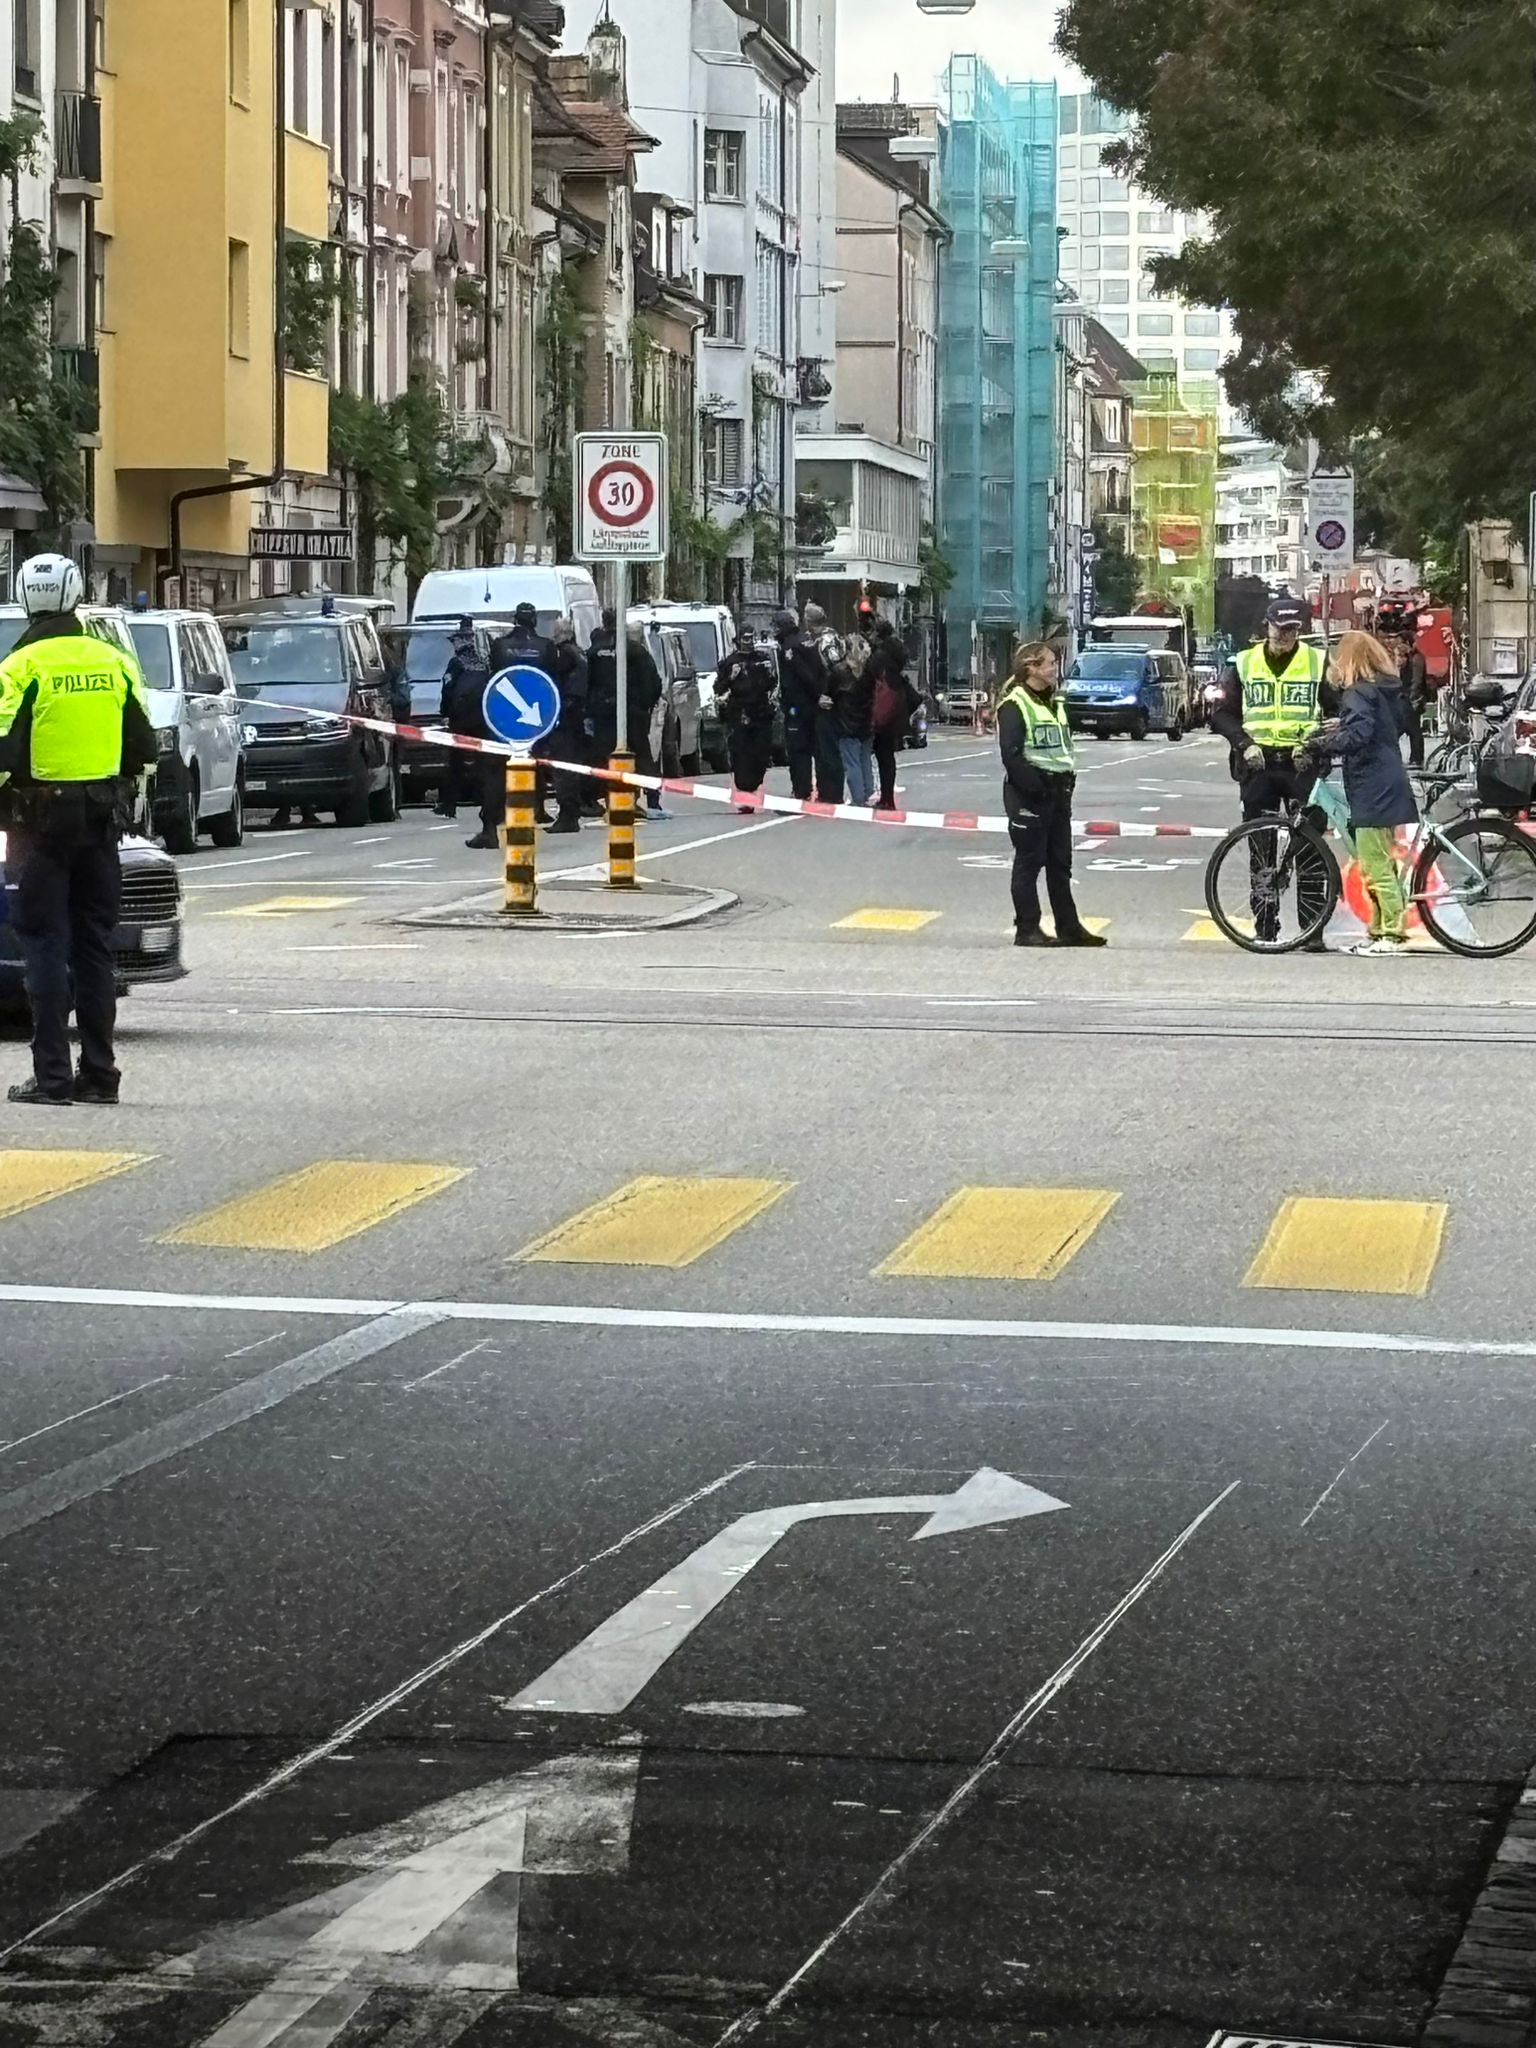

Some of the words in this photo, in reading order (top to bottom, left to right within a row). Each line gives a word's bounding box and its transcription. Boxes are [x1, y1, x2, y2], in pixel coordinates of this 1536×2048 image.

[601, 444, 641, 458] ZONE
[607, 481, 635, 507] 30
[52, 673, 114, 693] POLIZEI
